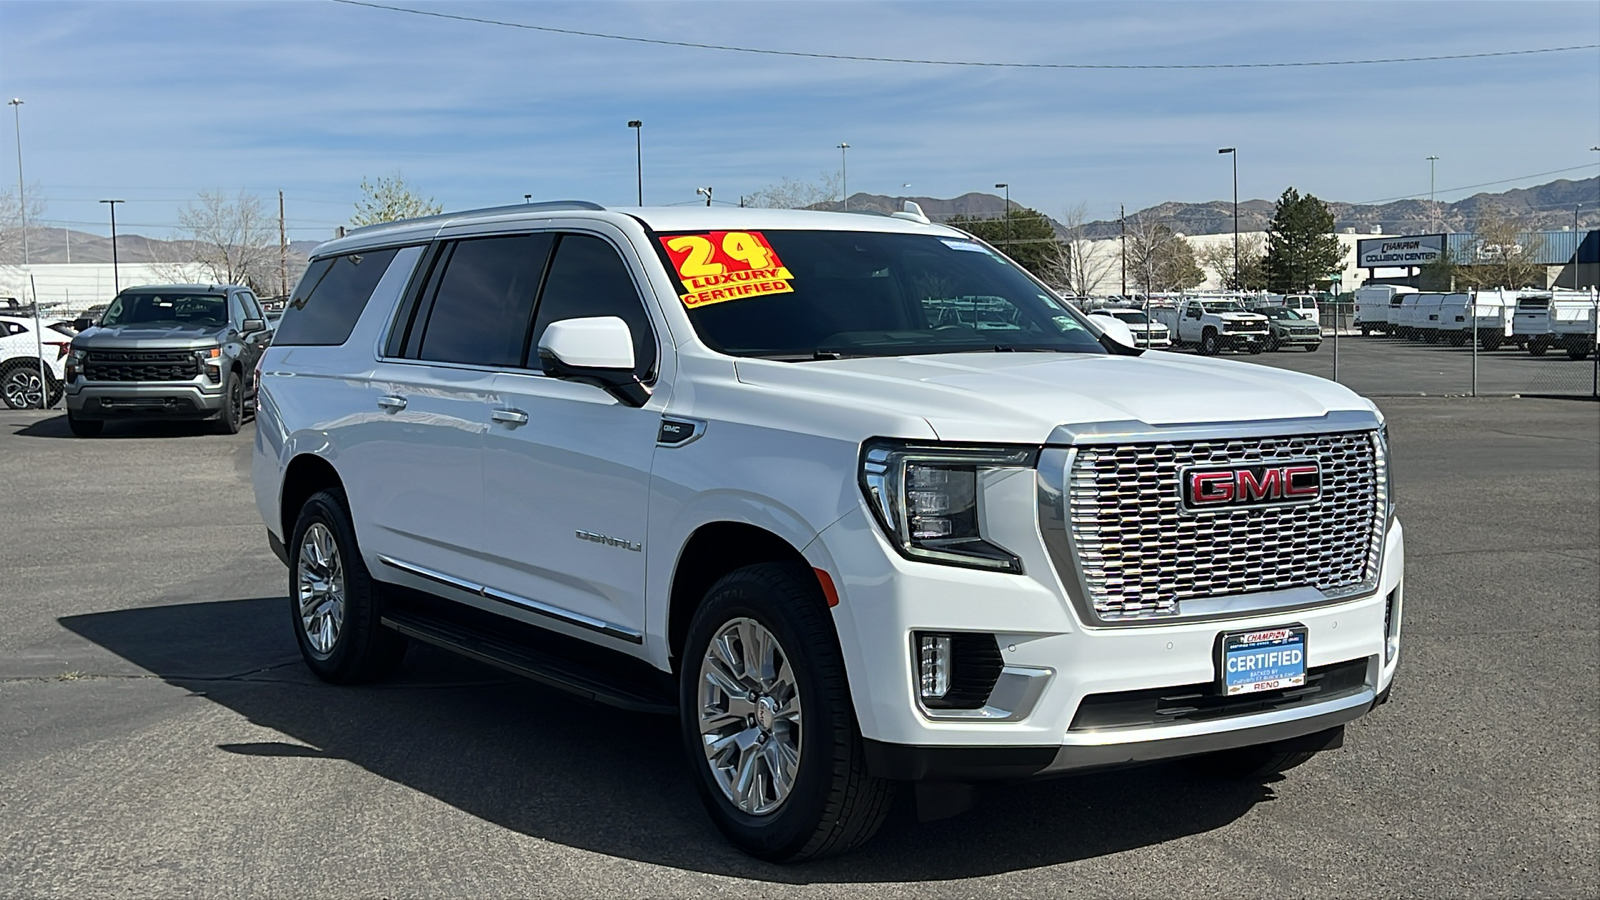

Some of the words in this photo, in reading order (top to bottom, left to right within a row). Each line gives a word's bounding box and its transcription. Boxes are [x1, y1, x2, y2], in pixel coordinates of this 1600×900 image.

[667, 232, 776, 277] 24
[1381, 241, 1420, 253] CHAMPION
[1366, 253, 1404, 262] COLLISION
[1405, 252, 1436, 261] CENTER
[692, 268, 779, 289] LUXURY
[684, 281, 788, 305] CERTIFIED
[663, 424, 680, 433] GMC
[1190, 466, 1319, 505] GMC
[575, 529, 642, 552] DENALI
[1246, 630, 1287, 642] CHAMPION
[1227, 649, 1302, 673] CERTIFIED
[1250, 670, 1271, 678] BACKED
[1253, 680, 1280, 691] RENO
